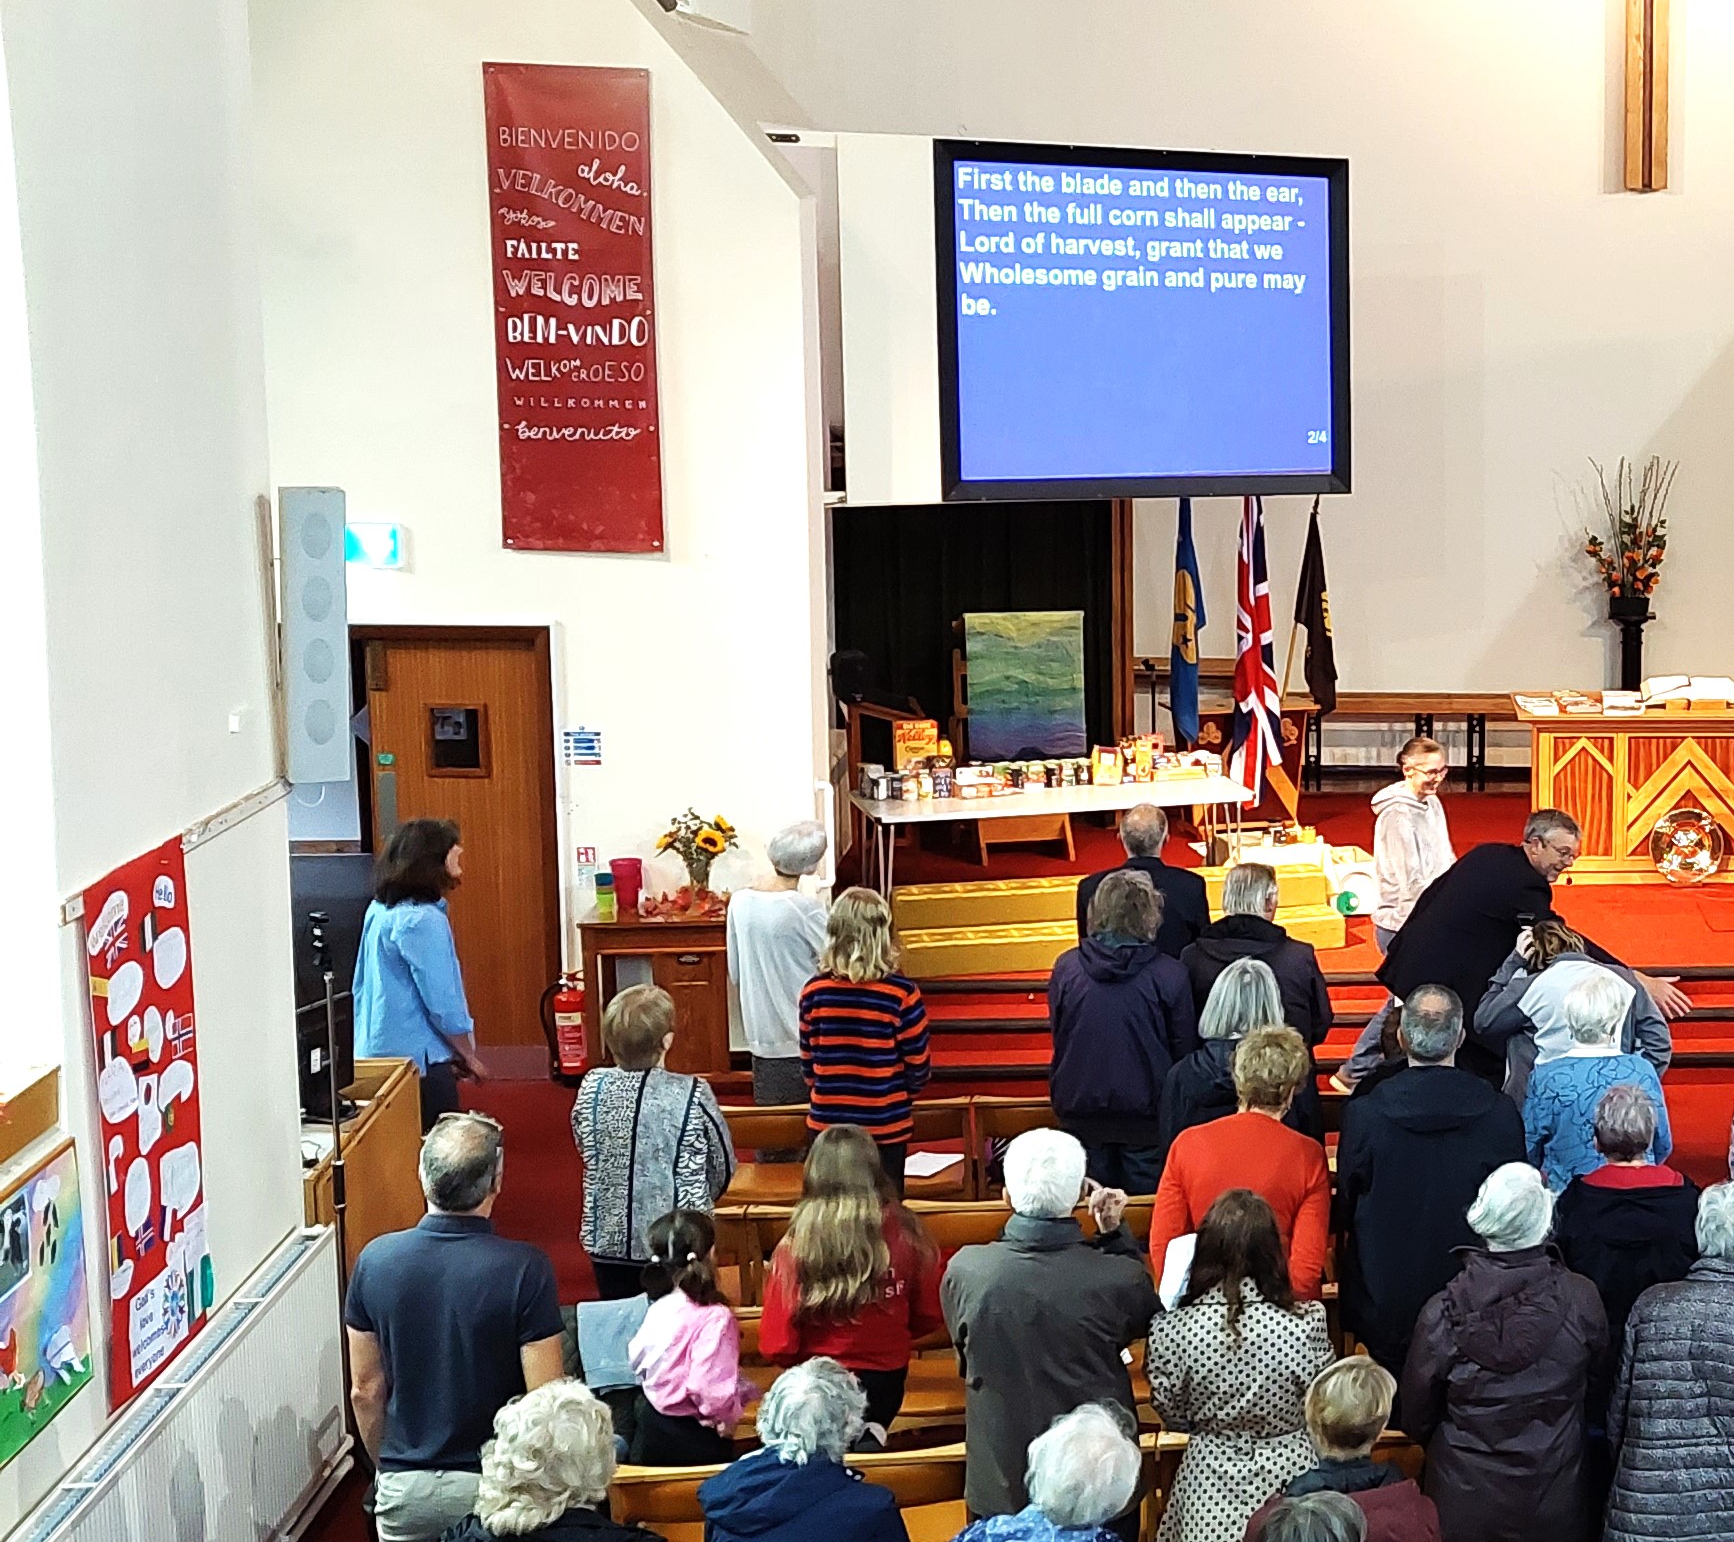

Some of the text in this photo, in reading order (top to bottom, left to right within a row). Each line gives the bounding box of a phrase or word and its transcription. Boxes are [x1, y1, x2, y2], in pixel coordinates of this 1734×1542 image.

[499, 126, 640, 152] BIENVENIDO
[577, 158, 642, 197] aloha
[957, 167, 1303, 206] First the blade and then the ear,
[496, 168, 646, 236] VELKOMMEN
[957, 198, 1018, 222] Then
[1023, 201, 1061, 224] the
[1065, 203, 1103, 225] full
[1108, 209, 1159, 227] corn
[1164, 207, 1215, 229] shall
[1221, 213, 1293, 235] appear
[959, 230, 1284, 262] Lord of harvest, grant that we
[502, 269, 644, 308] WELCOME
[959, 261, 1307, 296] Wholesome grain and pure may
[961, 292, 997, 316] be.
[507, 313, 649, 347] BEM-VINDO
[505, 357, 581, 381] WELKOM
[571, 361, 645, 382] CROESO
[513, 396, 648, 409] WILLKOMMEN
[514, 420, 642, 441] benvenuto
[1307, 430, 1328, 444] 2/4
[135, 1288, 156, 1311] God's
[139, 1312, 155, 1330] love
[134, 1346, 166, 1378] everyone
